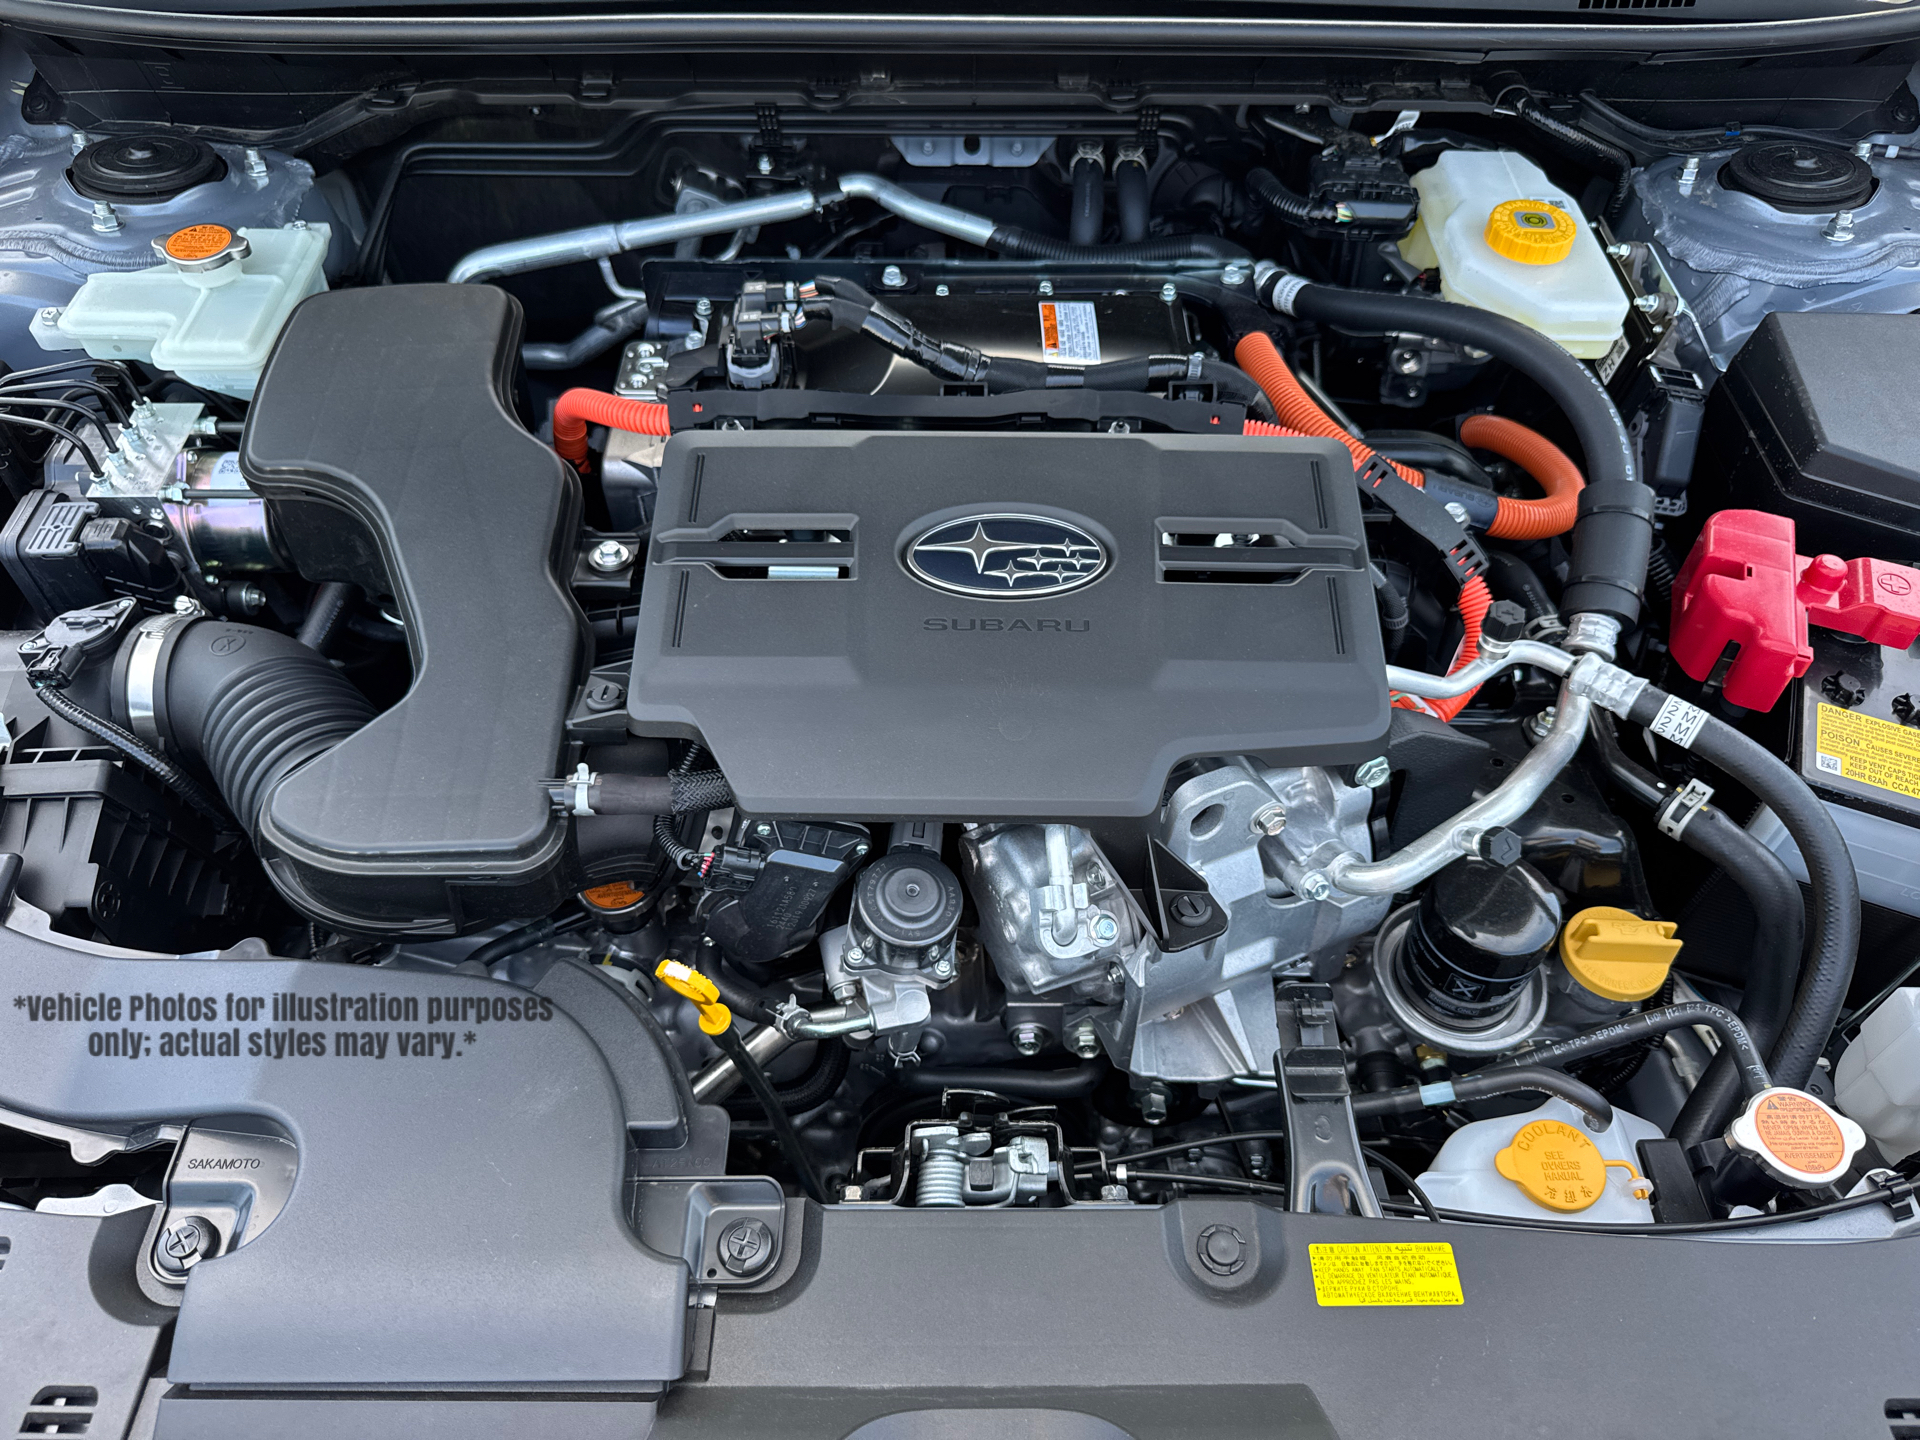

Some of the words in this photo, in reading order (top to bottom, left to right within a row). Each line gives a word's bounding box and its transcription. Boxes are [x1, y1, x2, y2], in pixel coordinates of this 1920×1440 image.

[1609, 409, 1621, 427] LP
[923, 618, 1090, 632] SUBARU
[1667, 704, 1679, 716] 2
[1681, 711, 1697, 725] M
[1821, 705, 1862, 722] DANGER
[1865, 718, 1901, 733] EXPLOSIVE
[1660, 716, 1672, 729] 2
[1674, 722, 1690, 737] M
[1821, 729, 1860, 747] POISON
[1866, 743, 1893, 756] CAUSES
[1849, 755, 1867, 764] KEEP
[1869, 760, 1886, 770] VENT
[1888, 766, 1906, 777] CAPS
[1849, 762, 1867, 771] KEEP
[1869, 767, 1883, 776] OUT
[1895, 776, 1919, 787] REACH
[1845, 768, 1867, 780] 20HR
[1868, 775, 1888, 787] 62Ah
[1891, 781, 1910, 794] CCA
[1429, 991, 1455, 1010] ENGINE
[1704, 1004, 1725, 1018] TPC
[1568, 1036, 1588, 1051] TPC
[1517, 1123, 1591, 1152] COOLANT
[188, 1158, 260, 1170] SAKAMOTO
[1544, 1151, 1565, 1160] SEE
[1541, 1161, 1581, 1170] OWNERS
[1544, 1171, 1584, 1181] MANUAL
[1337, 1245, 1360, 1253] CAUTION
[1362, 1245, 1392, 1253] ATTENTION
[1415, 1244, 1445, 1252] ВНИМАНИЕ
